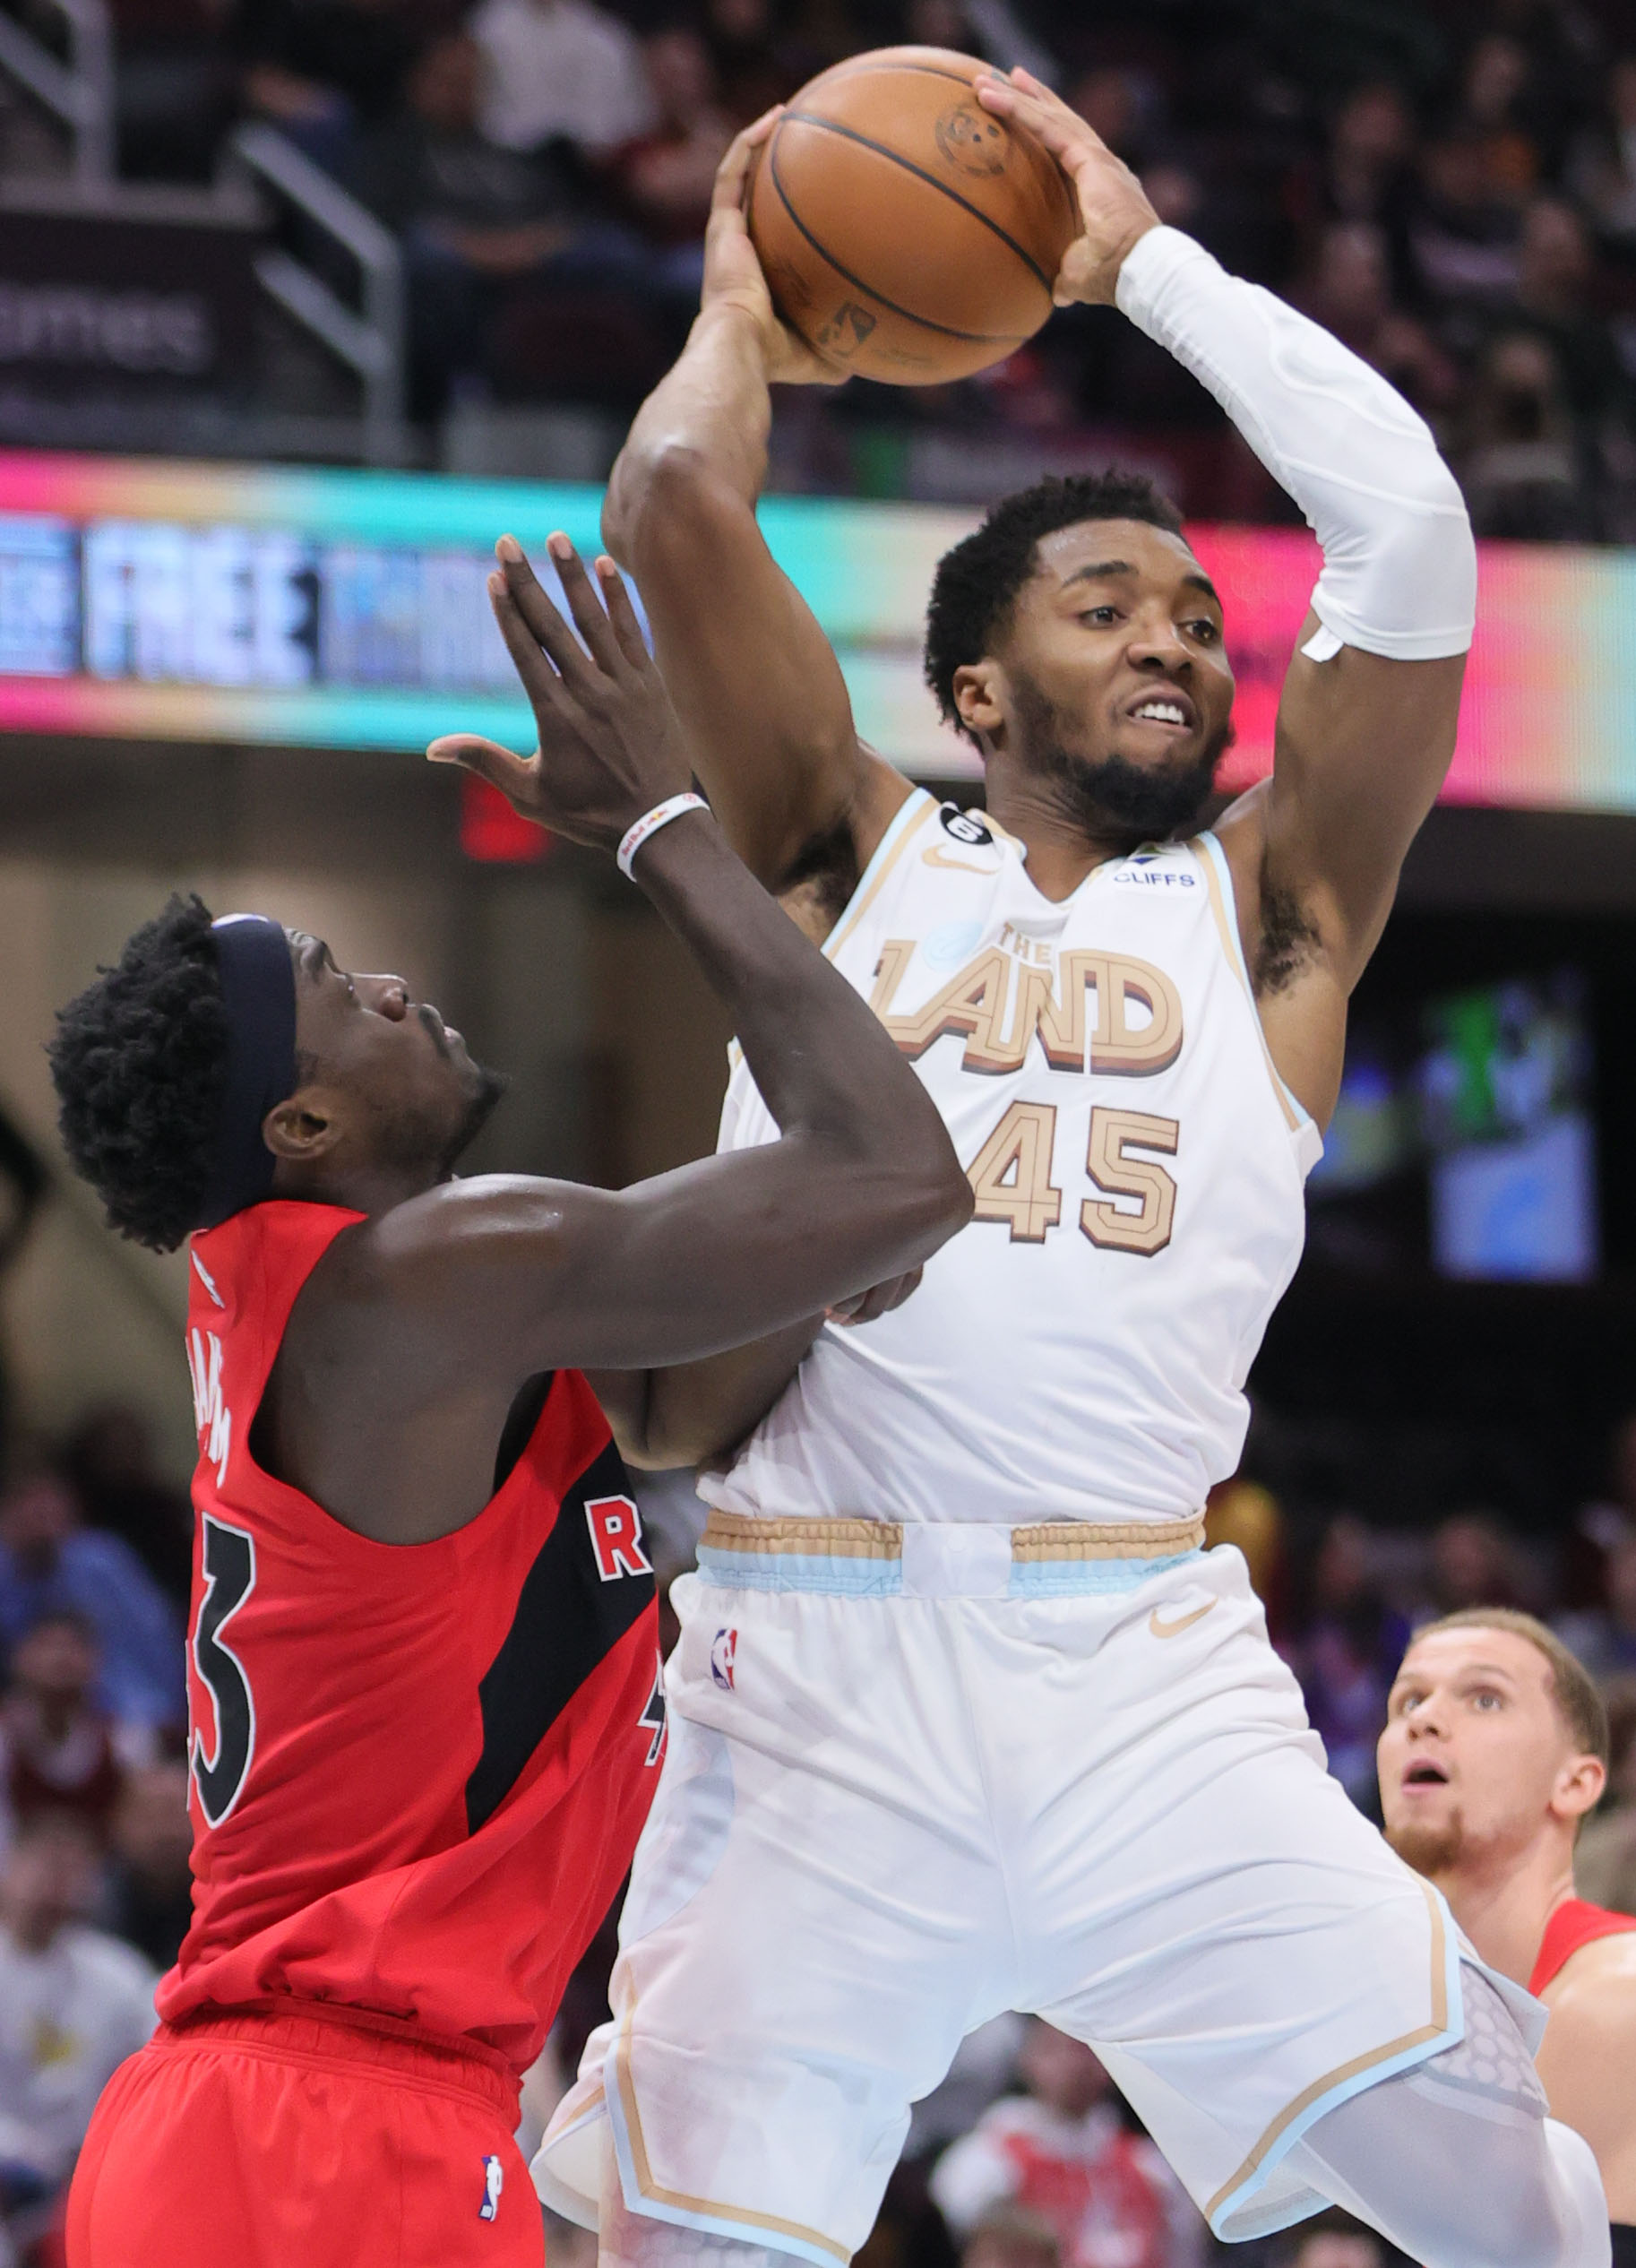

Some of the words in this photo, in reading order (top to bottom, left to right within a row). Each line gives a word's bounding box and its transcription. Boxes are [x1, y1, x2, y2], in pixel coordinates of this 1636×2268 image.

[946, 815, 984, 842] 6
[1114, 872, 1195, 887] CLIFFS
[998, 922, 1052, 964] THE
[869, 939, 1184, 1078] LAND
[965, 1100, 1179, 1257] 45
